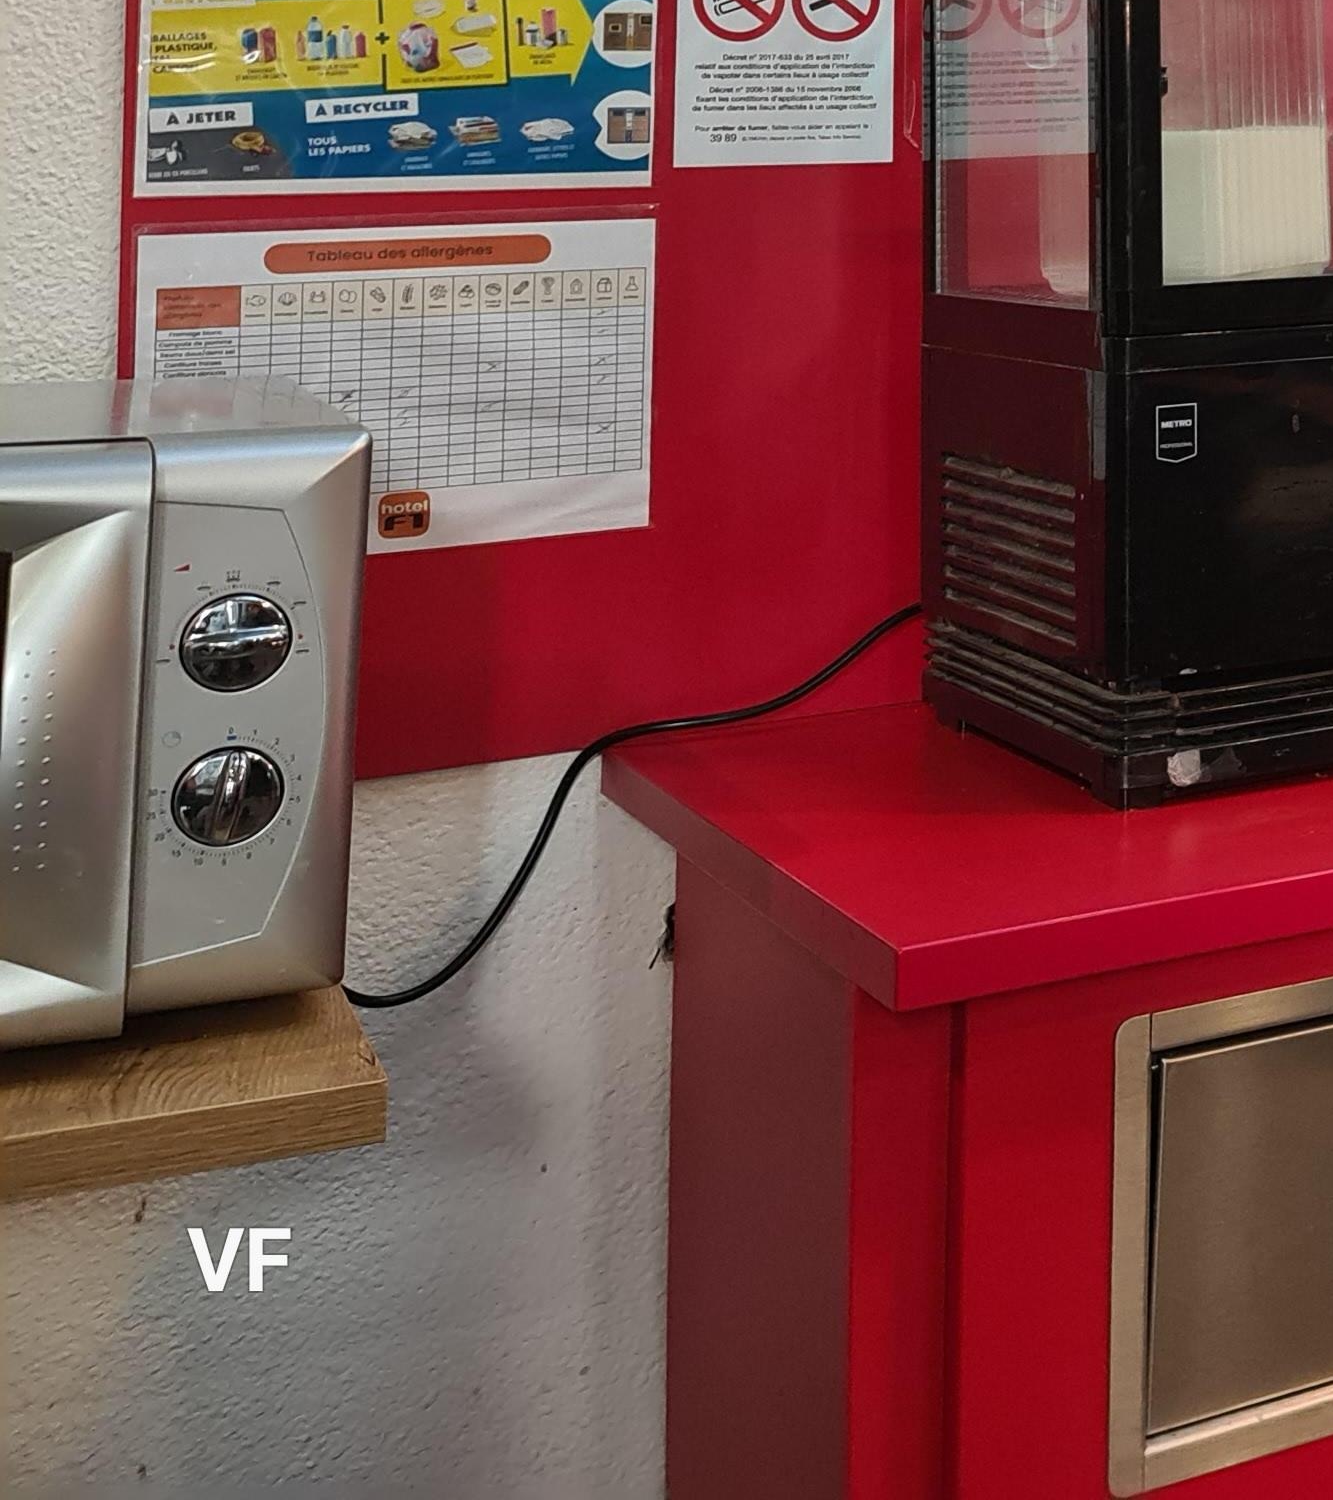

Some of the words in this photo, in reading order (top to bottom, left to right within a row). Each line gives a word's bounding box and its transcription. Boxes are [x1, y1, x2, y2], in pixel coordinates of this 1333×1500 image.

[333, 100, 409, 116] RECYCLER
[186, 110, 236, 124] JETER
[308, 136, 338, 146] TOUS
[710, 134, 722, 142] 39
[724, 134, 737, 142] 89
[308, 147, 326, 157] LES
[328, 144, 372, 156] PAPIERS
[308, 250, 373, 262] Tableau
[377, 248, 406, 260] des
[410, 244, 493, 260] allergènes
[1161, 419, 1192, 429] METRO
[381, 500, 428, 514] hotel
[384, 513, 423, 532] F1
